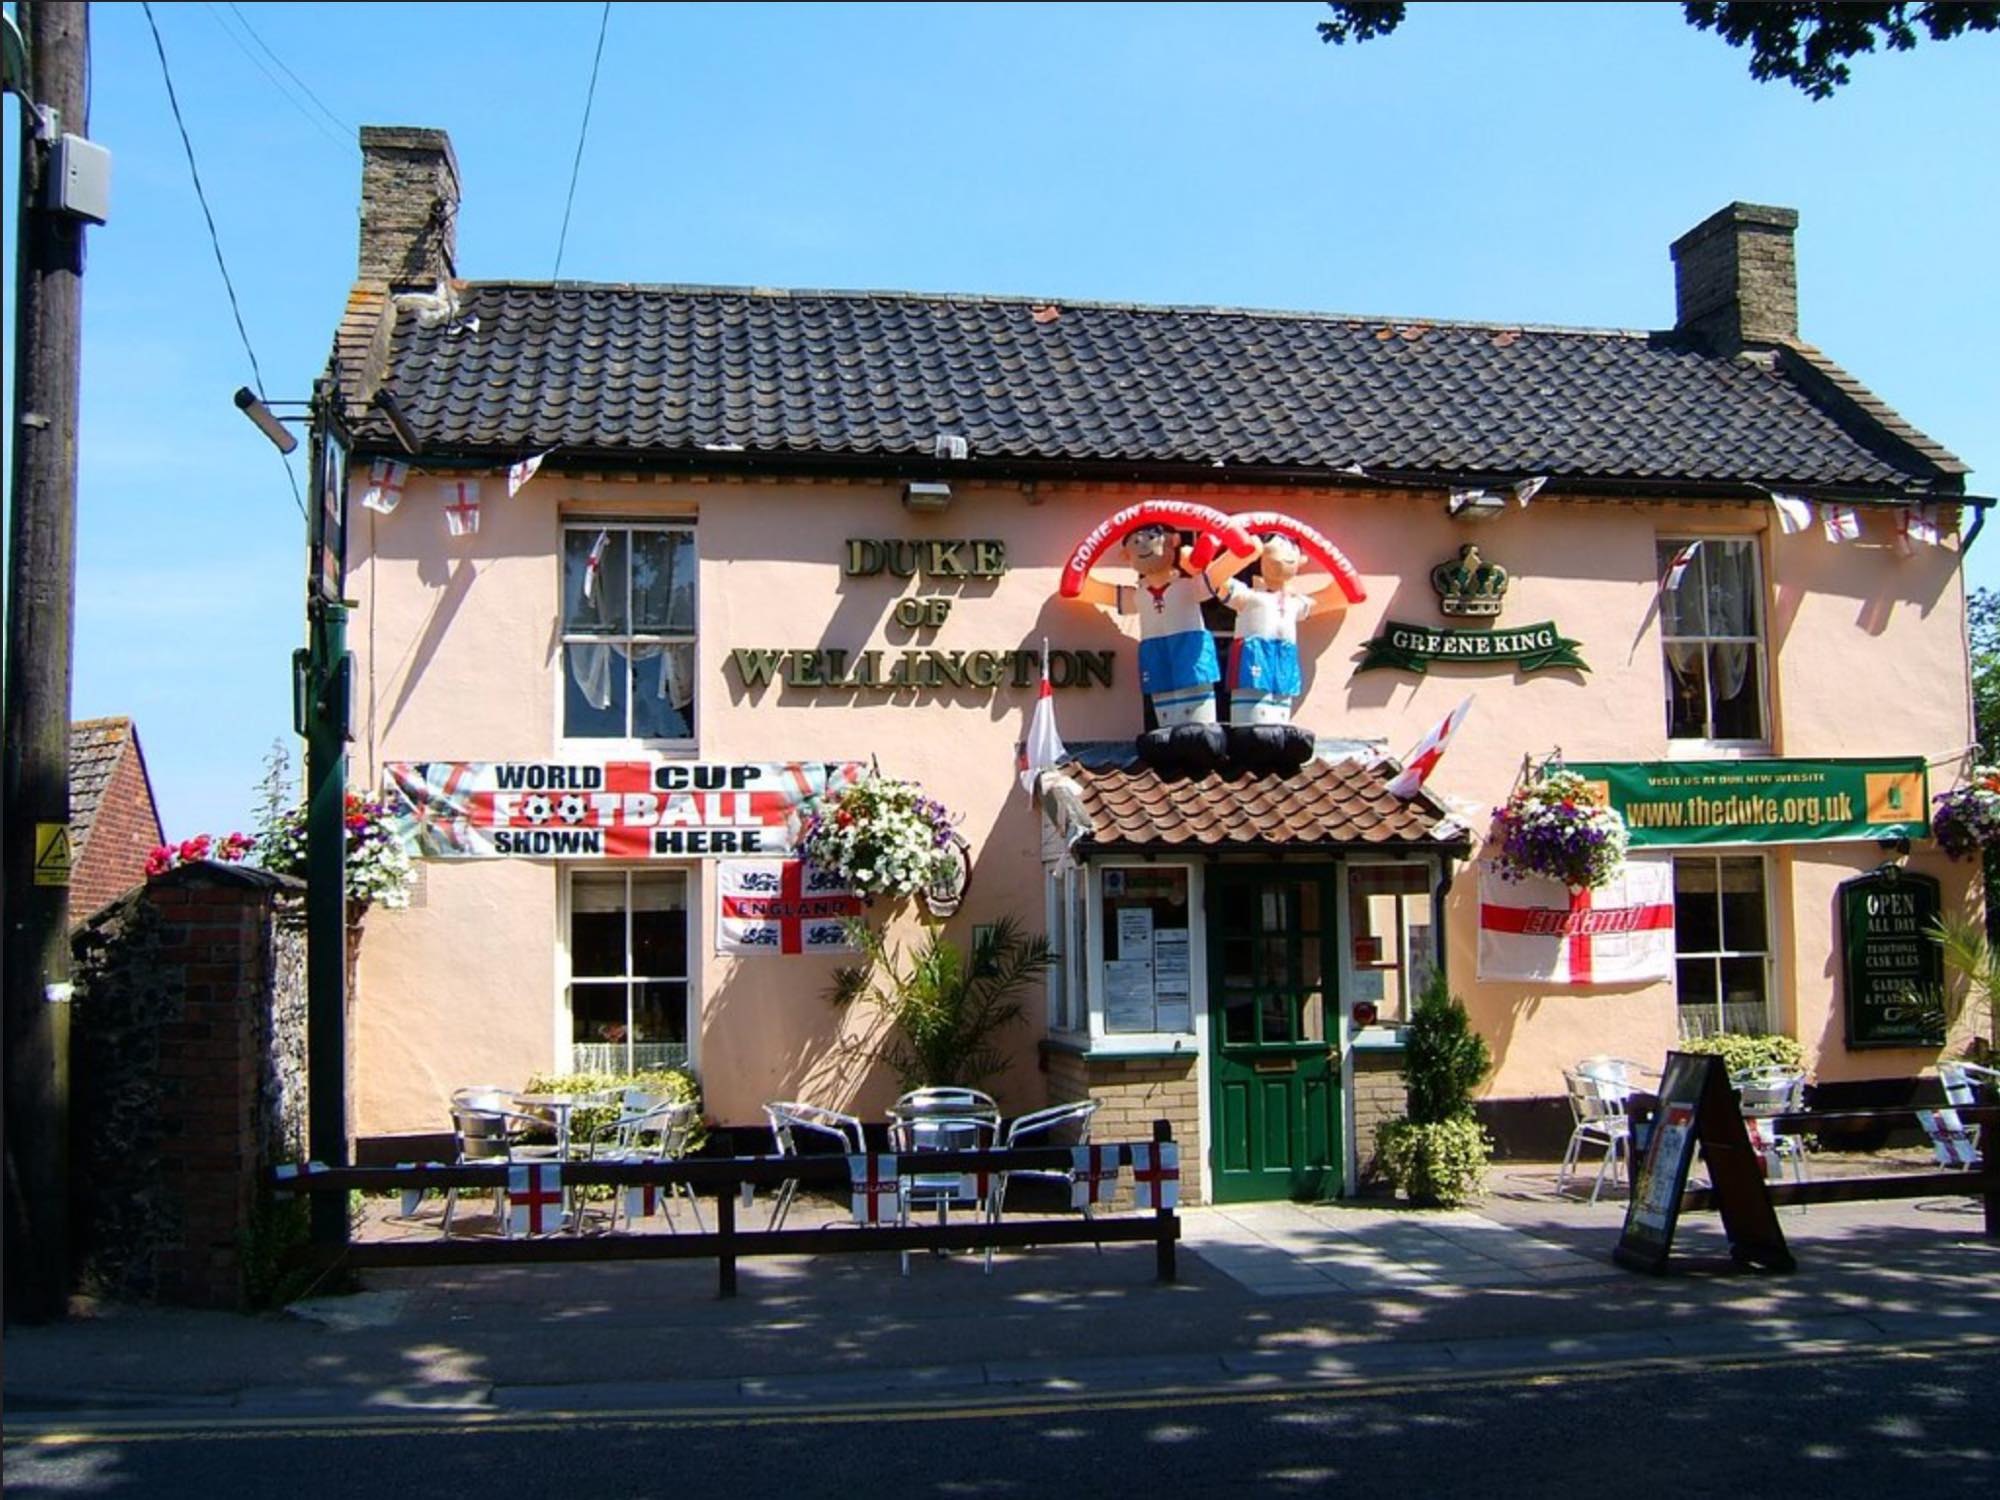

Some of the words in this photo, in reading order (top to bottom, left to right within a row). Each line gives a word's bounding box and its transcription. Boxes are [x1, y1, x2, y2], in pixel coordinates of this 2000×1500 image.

[1071, 519, 1112, 572] COME
[1113, 503, 1143, 526] ON
[845, 538, 1006, 577] DUKE
[896, 597, 952, 628] OF
[1393, 630, 1492, 653] GREENE
[1495, 629, 1553, 654] KING
[731, 648, 1116, 689] WELLINGTON
[495, 765, 601, 789] WORLD
[655, 765, 762, 790] CUP
[1648, 776, 1680, 786] VISIT
[1684, 776, 1700, 786] US
[1703, 776, 1716, 785] AT
[1719, 775, 1744, 785] OUR
[1746, 774, 1772, 784] NEW
[1775, 773, 1825, 783] WEBSITE
[492, 793, 764, 827] FOOTBALL
[1626, 792, 1852, 828] www.theduke.org.uk
[494, 830, 600, 853] SHOWN
[655, 830, 762, 854] HERE
[736, 901, 846, 917] ENGLAND
[1867, 894, 1915, 916] OPEN
[1868, 918, 1890, 932] ALL
[1895, 917, 1917, 931] DAY
